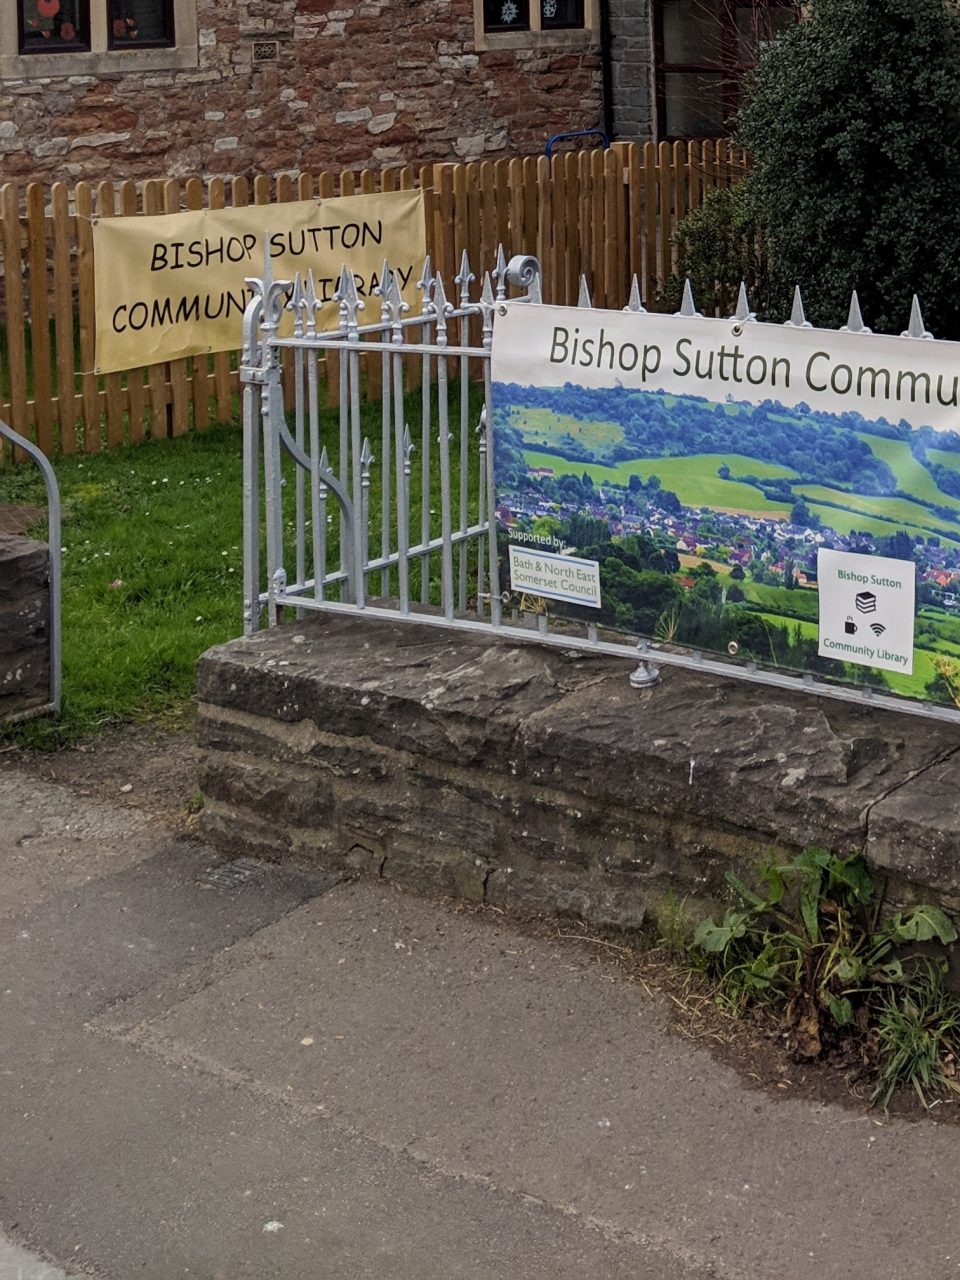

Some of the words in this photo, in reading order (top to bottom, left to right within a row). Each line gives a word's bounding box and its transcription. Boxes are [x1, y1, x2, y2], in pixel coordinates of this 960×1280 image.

[150, 234, 257, 272] BISHOP
[269, 220, 383, 258] SUTTON
[112, 282, 297, 333] COMMUNY
[549, 326, 662, 383] Bishop
[672, 337, 791, 388] Sutton
[508, 527, 551, 545] Supported
[513, 556, 533, 568] Bath
[535, 561, 542, 572] &
[544, 562, 575, 579] North
[576, 568, 596, 583] East
[513, 569, 558, 589] Somerset
[560, 579, 597, 596] Council
[837, 569, 869, 585] Bishop
[870, 574, 902, 589] Sutton
[823, 638, 875, 659] Community
[876, 649, 909, 666] Library
